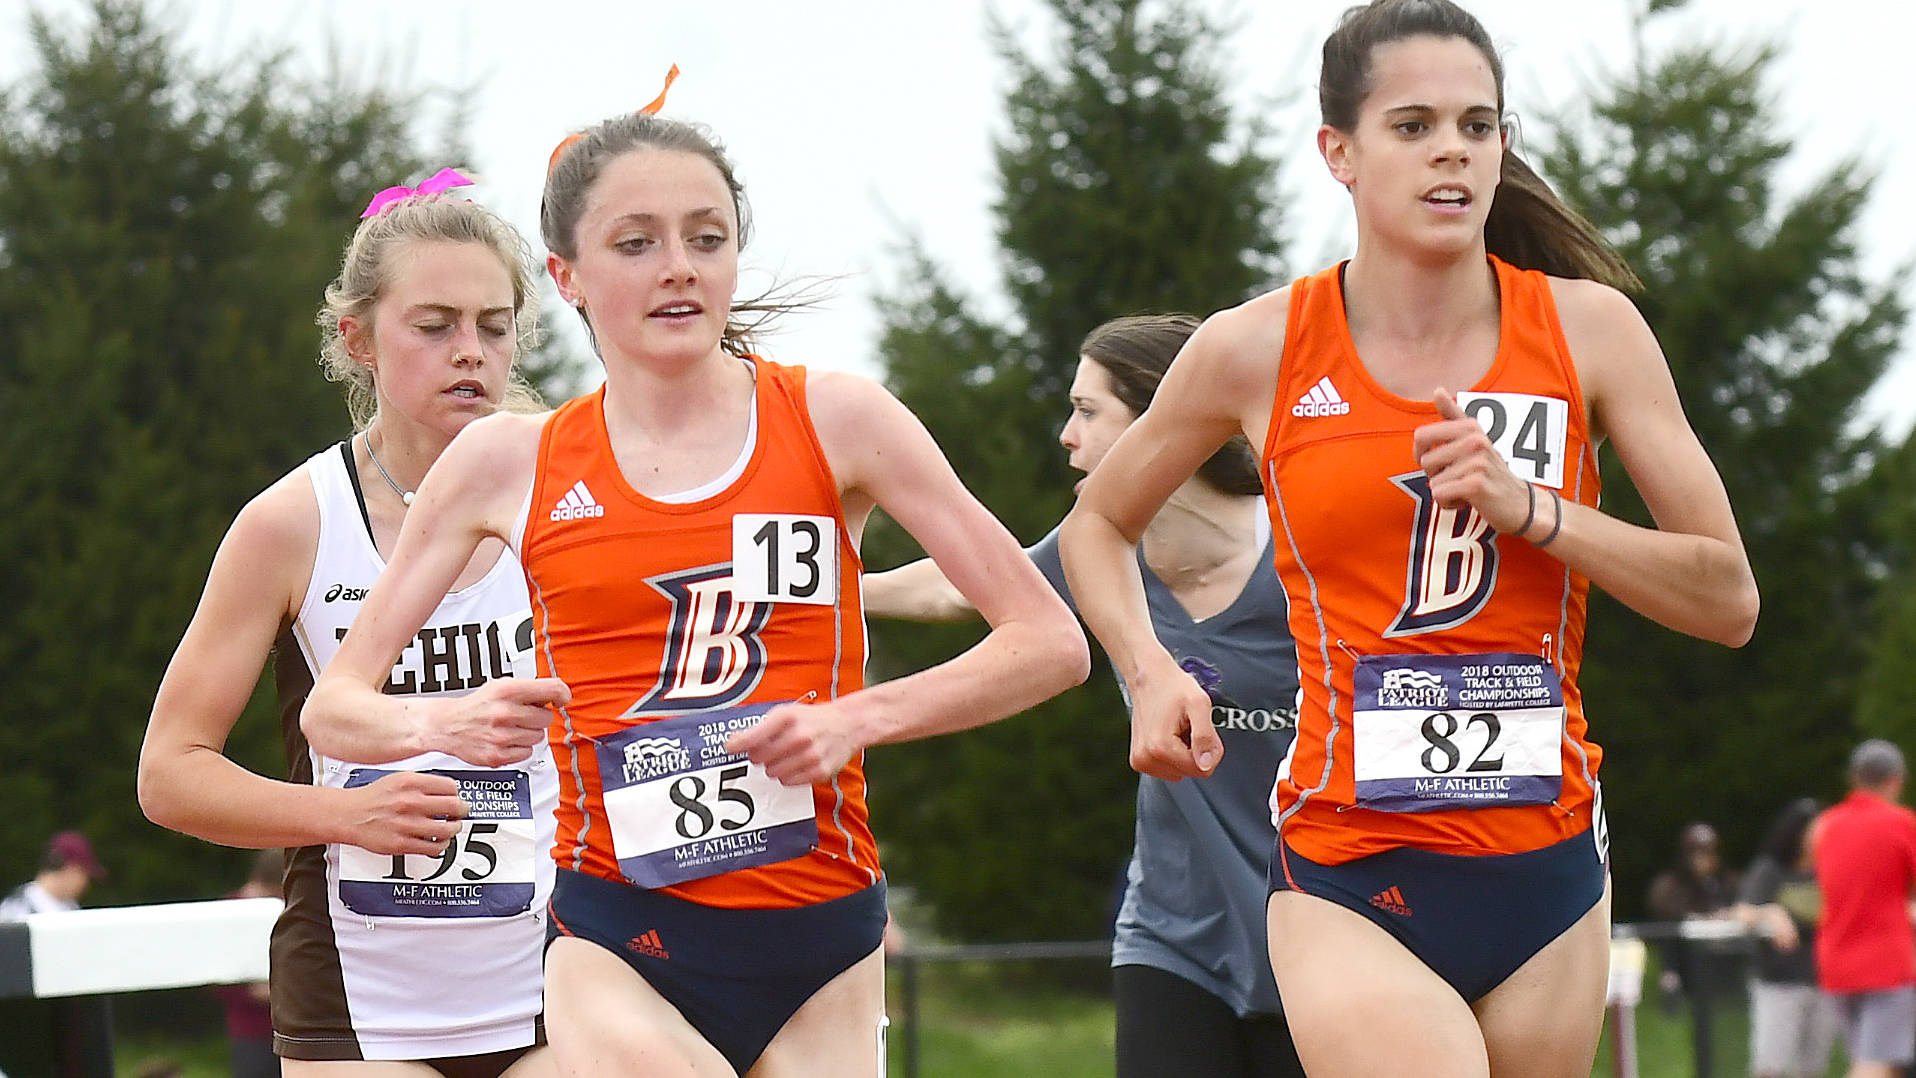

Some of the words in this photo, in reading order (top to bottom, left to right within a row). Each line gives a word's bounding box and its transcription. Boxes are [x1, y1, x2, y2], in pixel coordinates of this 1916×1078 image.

[1292, 401, 1350, 417] adidas
[551, 504, 604, 521] adidas
[753, 520, 821, 597] 13
[342, 588, 370, 601] asic
[336, 621, 514, 695] EHIG
[1461, 665, 1489, 677] 2018
[1492, 664, 1543, 676] OUTDOOR
[1464, 677, 1502, 688] TRACK
[1505, 676, 1514, 688] &
[1516, 675, 1541, 687] FIELD
[1378, 687, 1448, 698] PATRIOT
[1459, 687, 1550, 701] CHAMPIONSHIPS
[1378, 696, 1448, 707] LEAGUE
[698, 722, 726, 737] 2018
[728, 714, 768, 730] OUTD
[703, 731, 732, 747] TRAC
[1421, 712, 1505, 774] 82
[622, 749, 690, 773] PATRIOT
[624, 757, 692, 784] LEAGUE
[463, 780, 516, 791] OUTDOOR
[1415, 778, 1441, 792] M-F
[1445, 777, 1511, 791] ATHLETIC
[475, 790, 484, 801] &
[487, 790, 513, 801] FIELD
[669, 764, 755, 839] 85
[468, 800, 520, 811] PIONSHIPS
[674, 842, 700, 861] M-F
[703, 829, 768, 856] ATHLETIC
[393, 884, 418, 897] M-F
[421, 885, 483, 898] ATHLETIC
